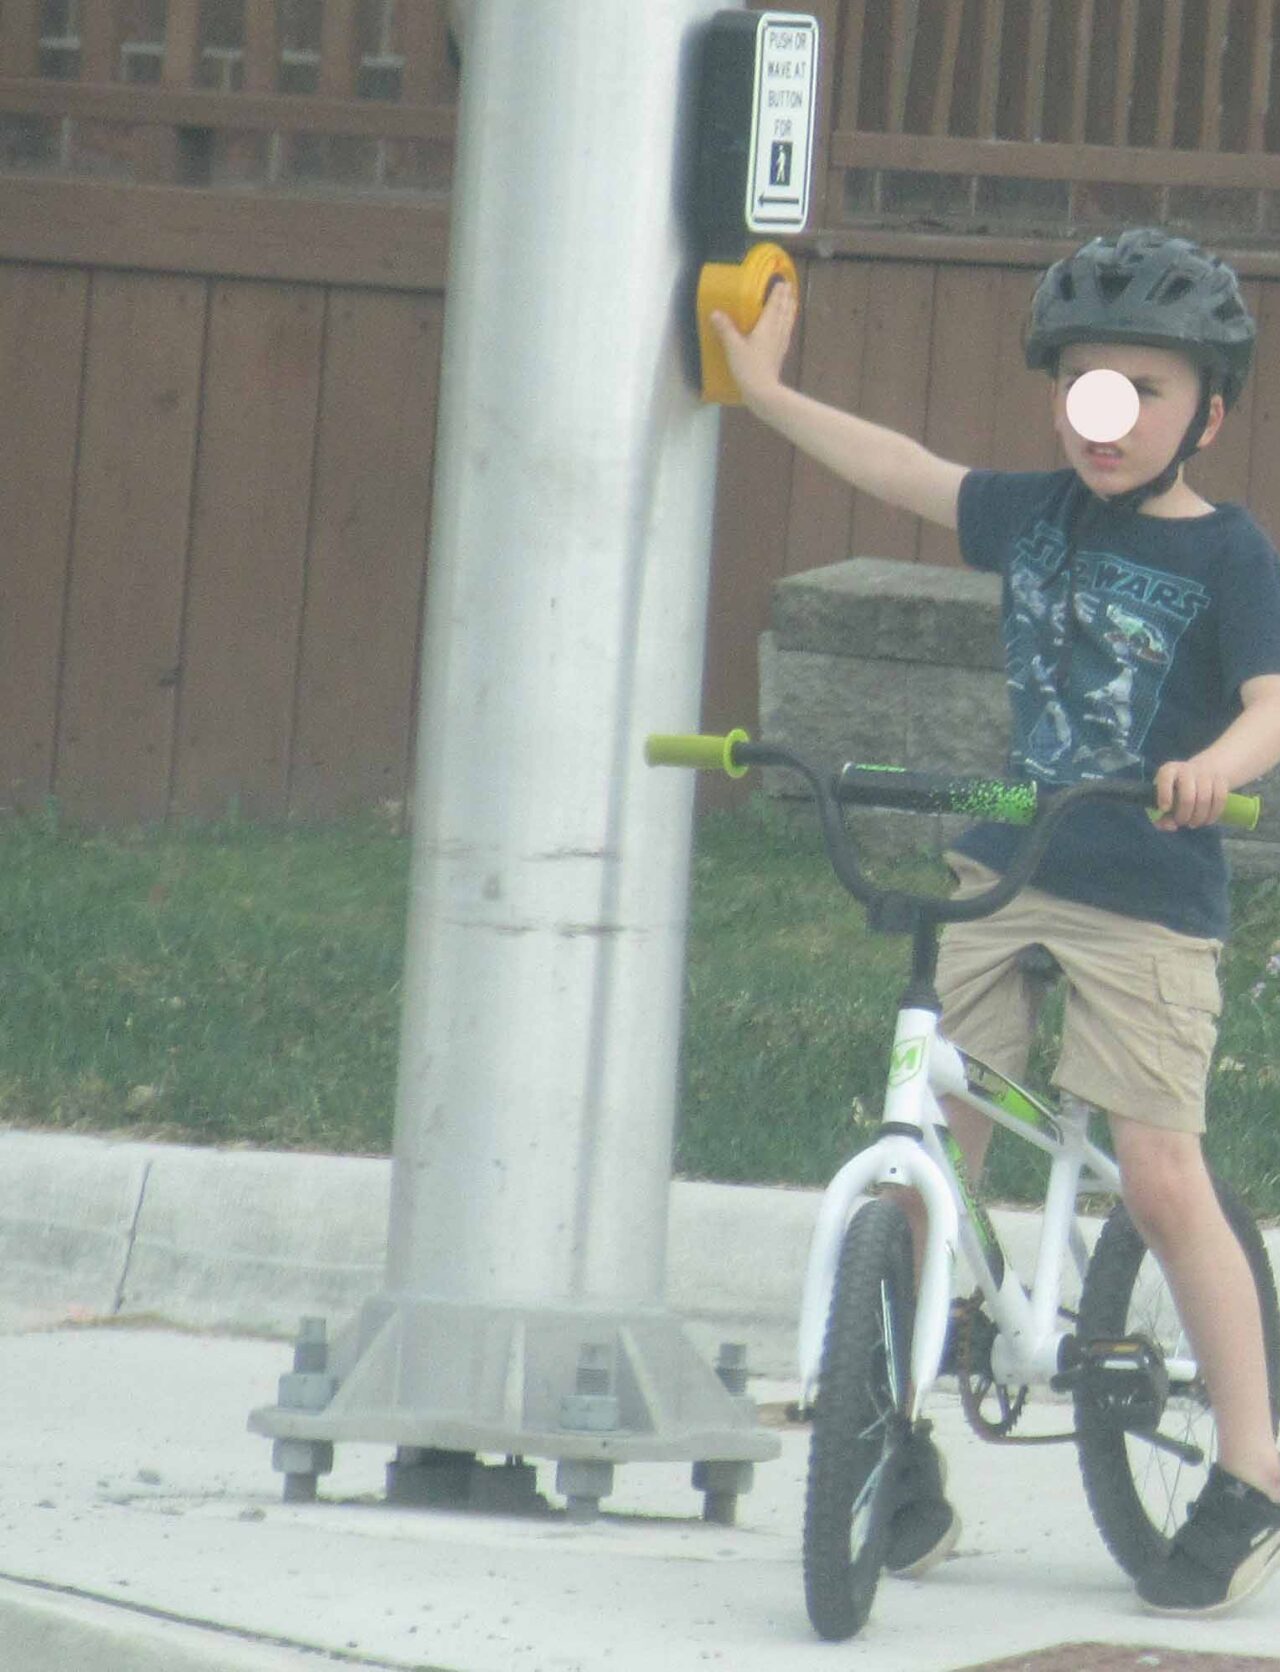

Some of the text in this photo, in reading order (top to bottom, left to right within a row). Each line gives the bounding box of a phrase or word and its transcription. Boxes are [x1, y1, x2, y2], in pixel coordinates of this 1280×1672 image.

[770, 32, 806, 50] PUSH OR
[768, 61, 806, 79] WAVE AT
[768, 90, 803, 108] BUTTON
[774, 119, 792, 137] FOR
[1091, 559, 1211, 621] WARS
